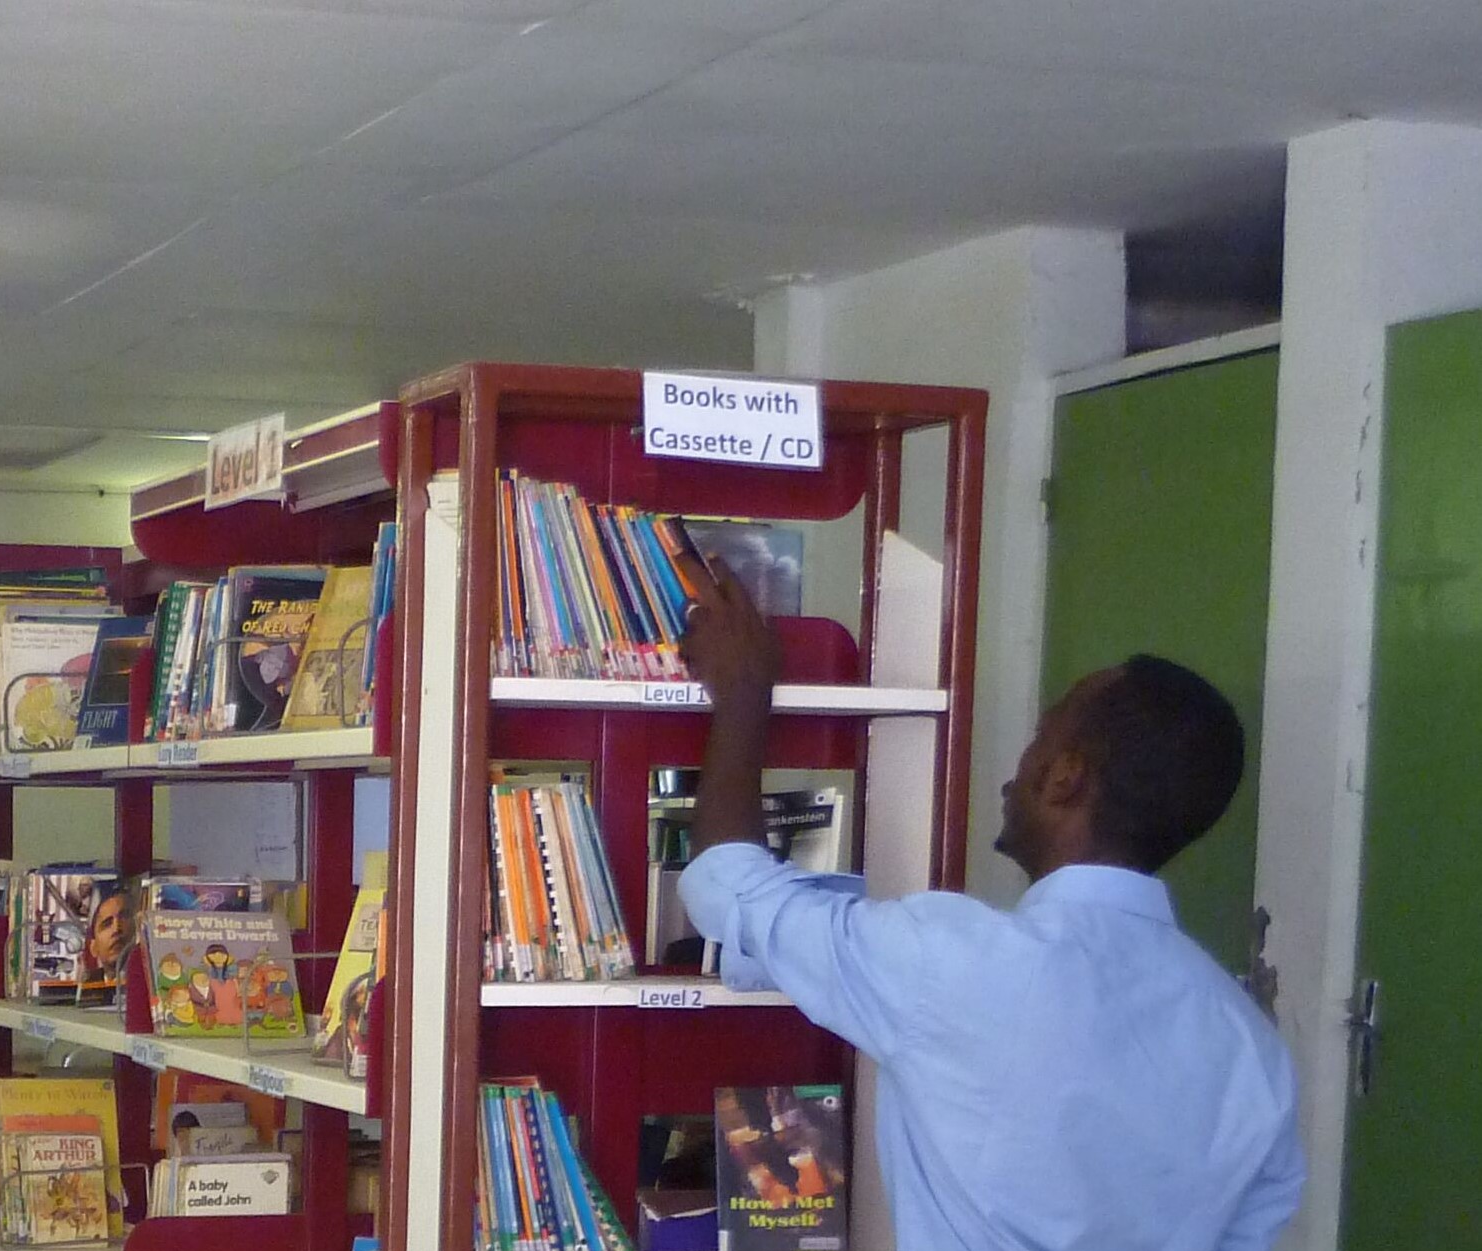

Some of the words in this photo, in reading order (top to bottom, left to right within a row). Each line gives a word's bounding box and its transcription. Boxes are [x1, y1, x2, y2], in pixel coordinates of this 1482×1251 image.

[664, 383, 737, 410] Books
[744, 391, 798, 415] with
[649, 426, 753, 456] Cassette
[760, 433, 773, 461] /
[780, 437, 814, 460] CD
[211, 431, 261, 494] Level
[266, 430, 277, 481] 1
[251, 601, 275, 615] THE
[241, 621, 259, 633] OF
[644, 685, 690, 703] Level
[697, 687, 706, 703] 1
[81, 709, 118, 731] FLIGHT
[154, 916, 193, 929] Snow
[197, 916, 243, 930] White
[246, 918, 275, 930] and
[153, 929, 178, 939] the
[180, 928, 222, 940] Seven
[226, 930, 280, 942] Dwarfs
[640, 989, 686, 1006] Level
[692, 990, 702, 1007] 2
[59, 1138, 96, 1150] KING
[33, 1151, 97, 1162] ARTHUR
[188, 1180, 197, 1191] A
[199, 1179, 228, 1193] baby
[188, 1195, 222, 1207] called
[224, 1194, 252, 1206] John
[729, 1197, 774, 1210] How
[782, 1197, 789, 1210] I
[795, 1195, 835, 1209] Met
[749, 1214, 817, 1230] Myself
